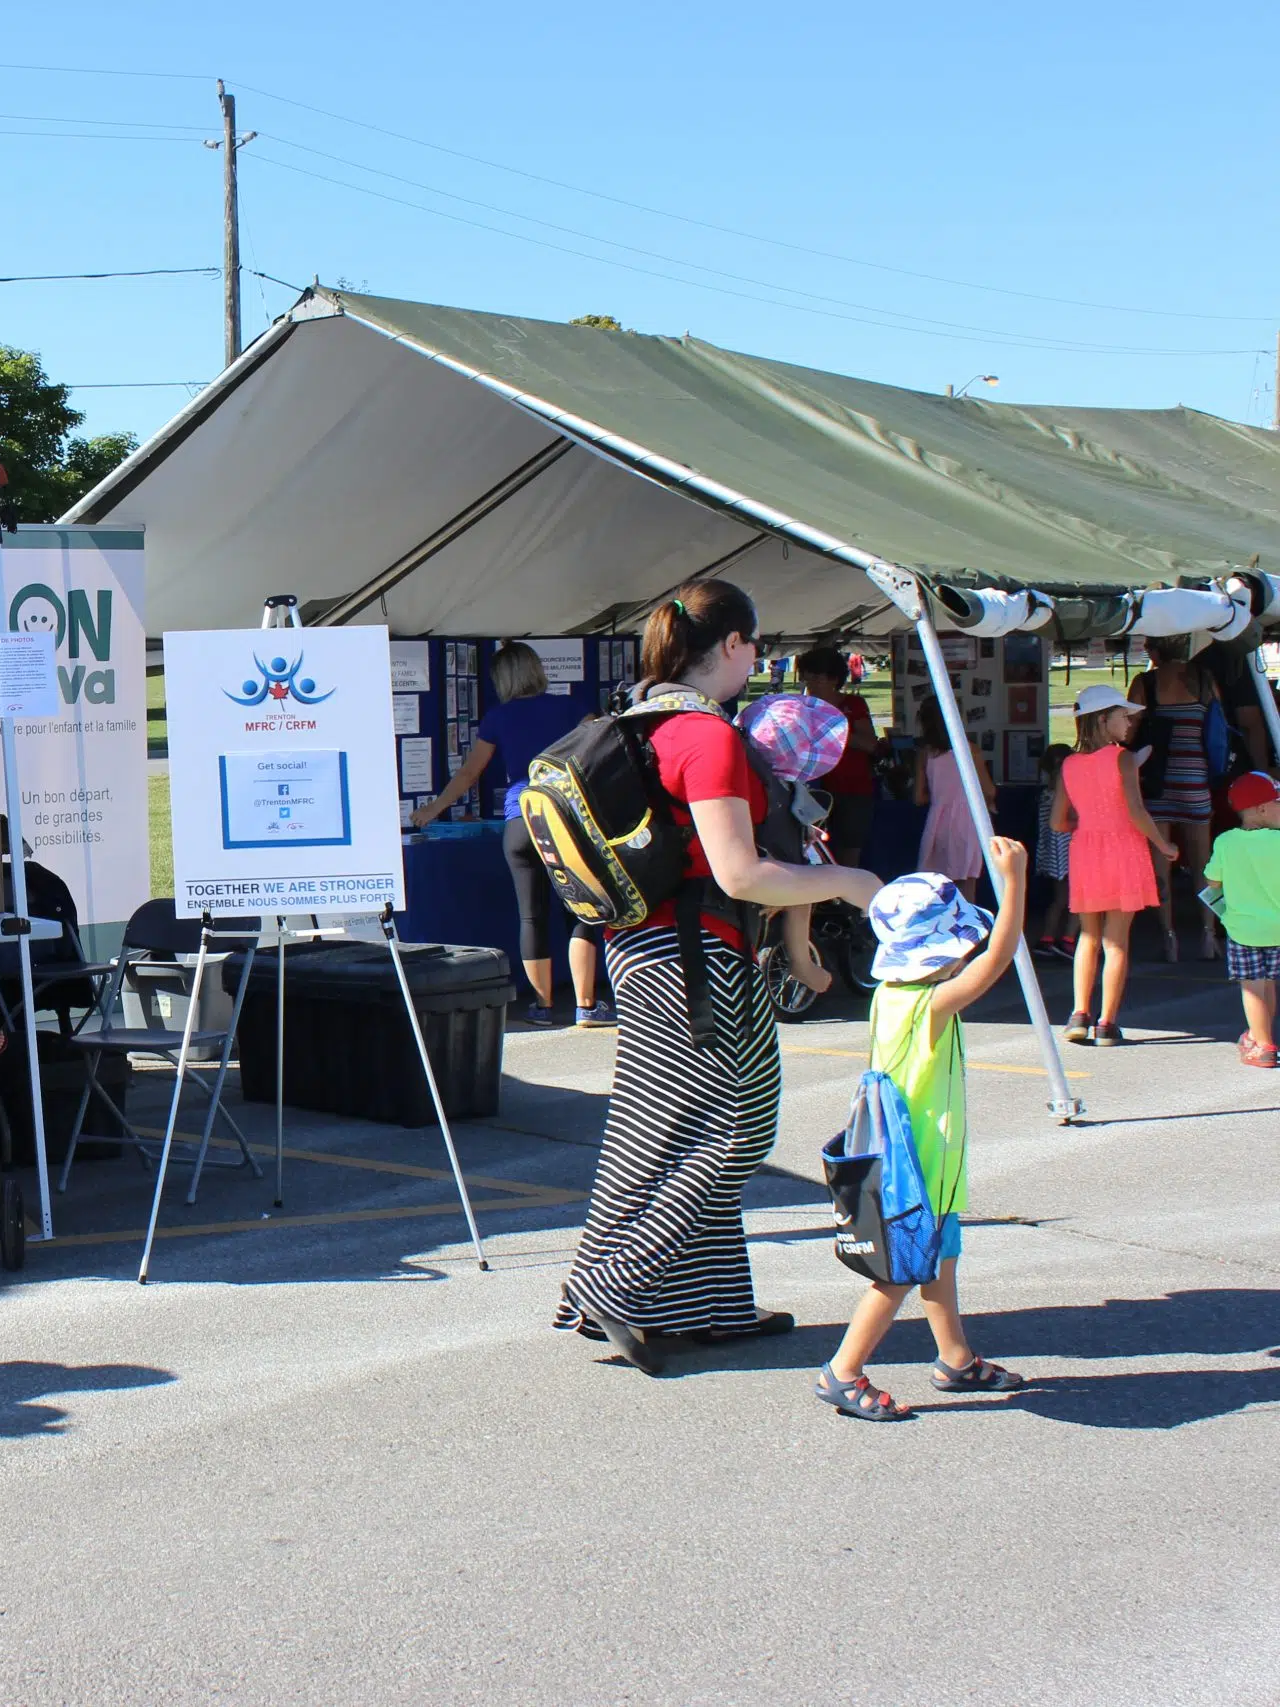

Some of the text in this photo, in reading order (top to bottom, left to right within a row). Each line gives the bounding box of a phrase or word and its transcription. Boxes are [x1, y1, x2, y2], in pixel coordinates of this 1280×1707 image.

[9, 583, 112, 661] ON
[57, 665, 115, 705] va
[25, 724, 47, 737] pour
[49, 721, 82, 734] l'enfant
[84, 721, 94, 732] et
[96, 720, 104, 732] la
[106, 719, 137, 731] famille
[245, 721, 276, 732] MFRC
[285, 720, 317, 730] CRFM
[257, 761, 307, 771] Get social!
[22, 787, 114, 805] Un bon départ,
[254, 797, 315, 807] @TrentonMFRC
[34, 809, 103, 828] de grandes
[34, 829, 105, 850] possibilités.
[186, 878, 394, 896] TOGETHER WE ARE STRONGER
[187, 892, 395, 909] ENSEMBLE NOUS SOMMES PLUS FORTS
[842, 1241, 875, 1254] CRFM
